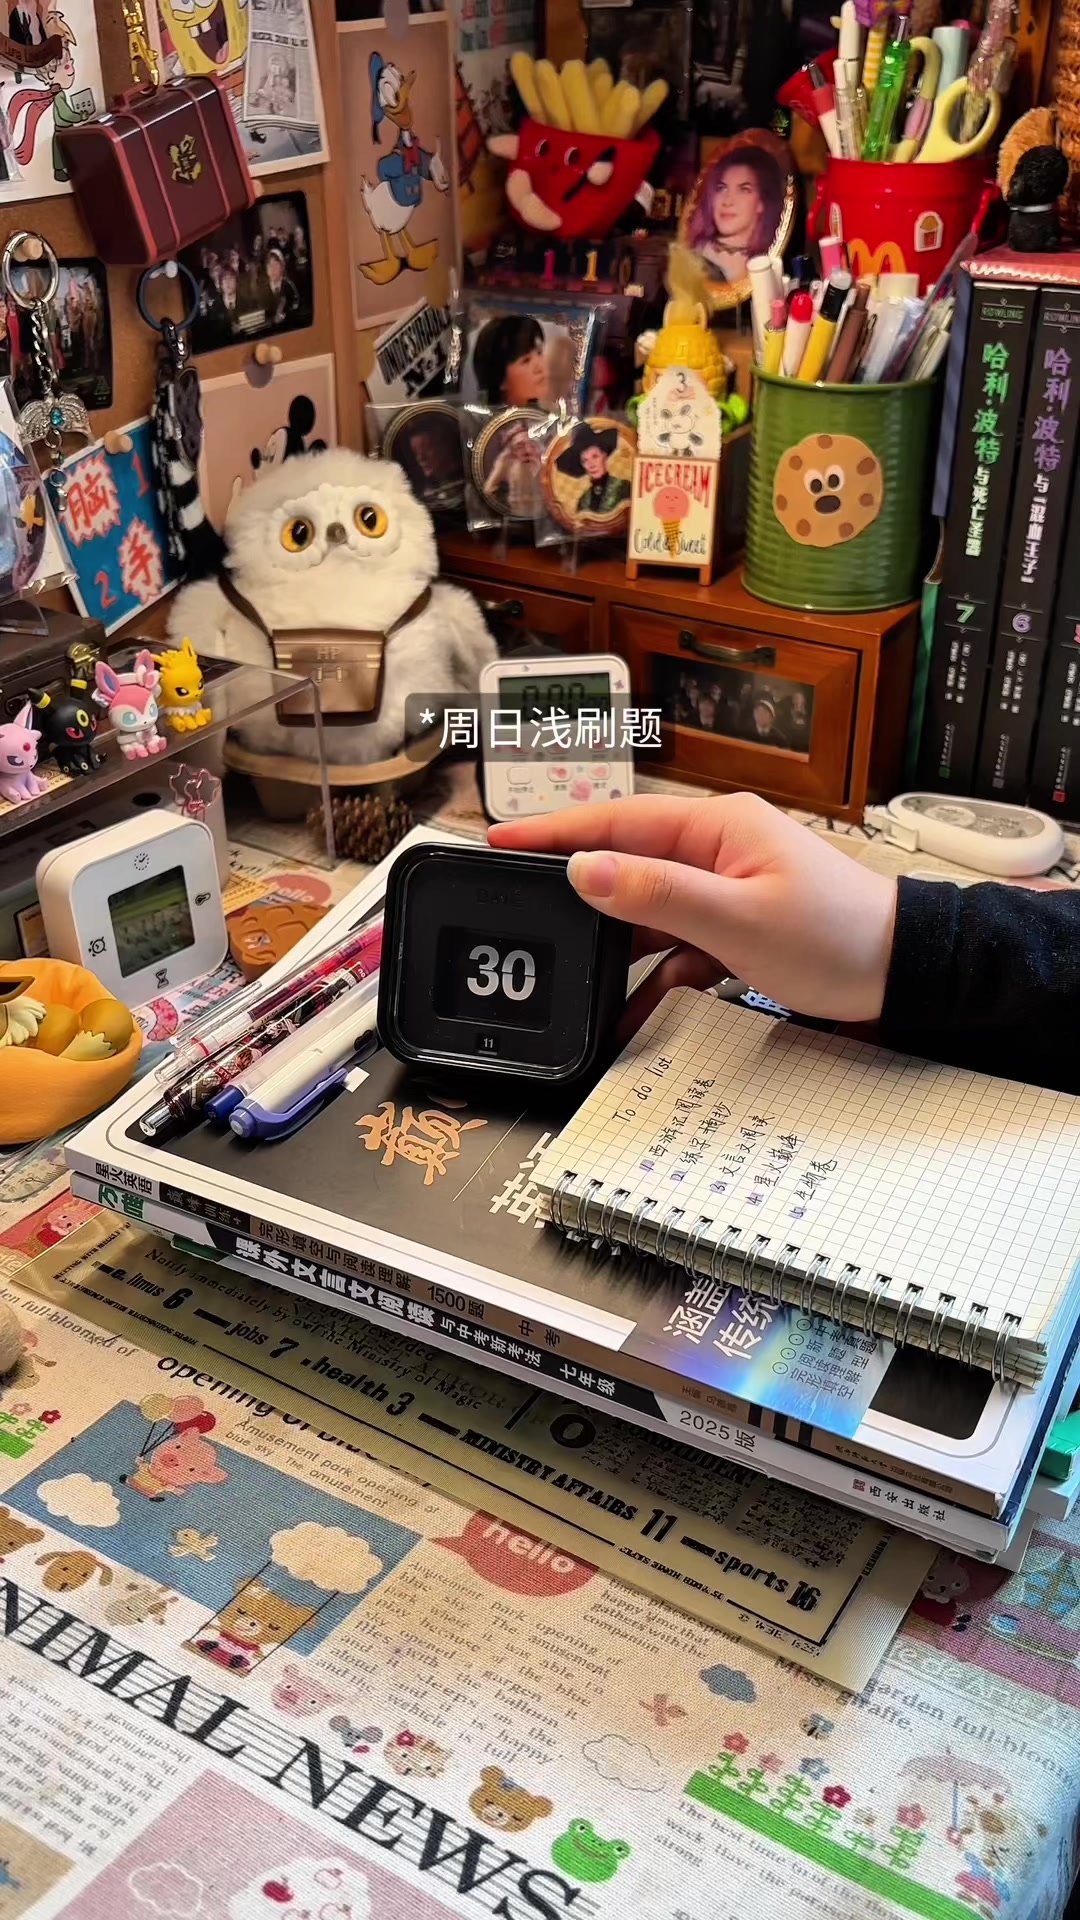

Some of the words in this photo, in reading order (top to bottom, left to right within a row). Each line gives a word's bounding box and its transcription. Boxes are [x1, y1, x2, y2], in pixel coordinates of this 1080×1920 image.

[131, 452, 150, 496] 1
[94, 571, 117, 609] 2
[956, 602, 976, 623] 7
[1012, 612, 1032, 633] 6
[317, 647, 343, 660] HP
[466, 944, 537, 1001] 30
[483, 1037, 494, 1048] 11
[612, 1107, 637, 1124] To
[634, 1084, 652, 1101] do
[644, 1057, 673, 1078] list
[355, 1096, 489, 1186] 巅
[95, 1162, 154, 1194] 星火英语
[258, 1222, 413, 1292] 完形填空与阅读理解
[235, 1236, 435, 1328] 课外文言文阅读
[559, 1363, 616, 1397] 七年级
[157, 1356, 275, 1418] opening
[162, 1287, 194, 1310] 6
[225, 1321, 270, 1346] jobs
[268, 1337, 300, 1359] 7
[312, 1356, 390, 1401] health
[385, 1392, 416, 1416] 3
[640, 1508, 678, 1542] 11
[714, 1551, 789, 1594] sports
[787, 1580, 822, 1612] 16
[225, 1430, 252, 1449] blue
[254, 1444, 275, 1458] sky
[236, 1418, 319, 1462] Amusement
[322, 1459, 353, 1478] park
[868, 1485, 947, 1522] 西安出版社
[482, 1521, 577, 1574] hello
[262, 1736, 581, 1920] NEWS
